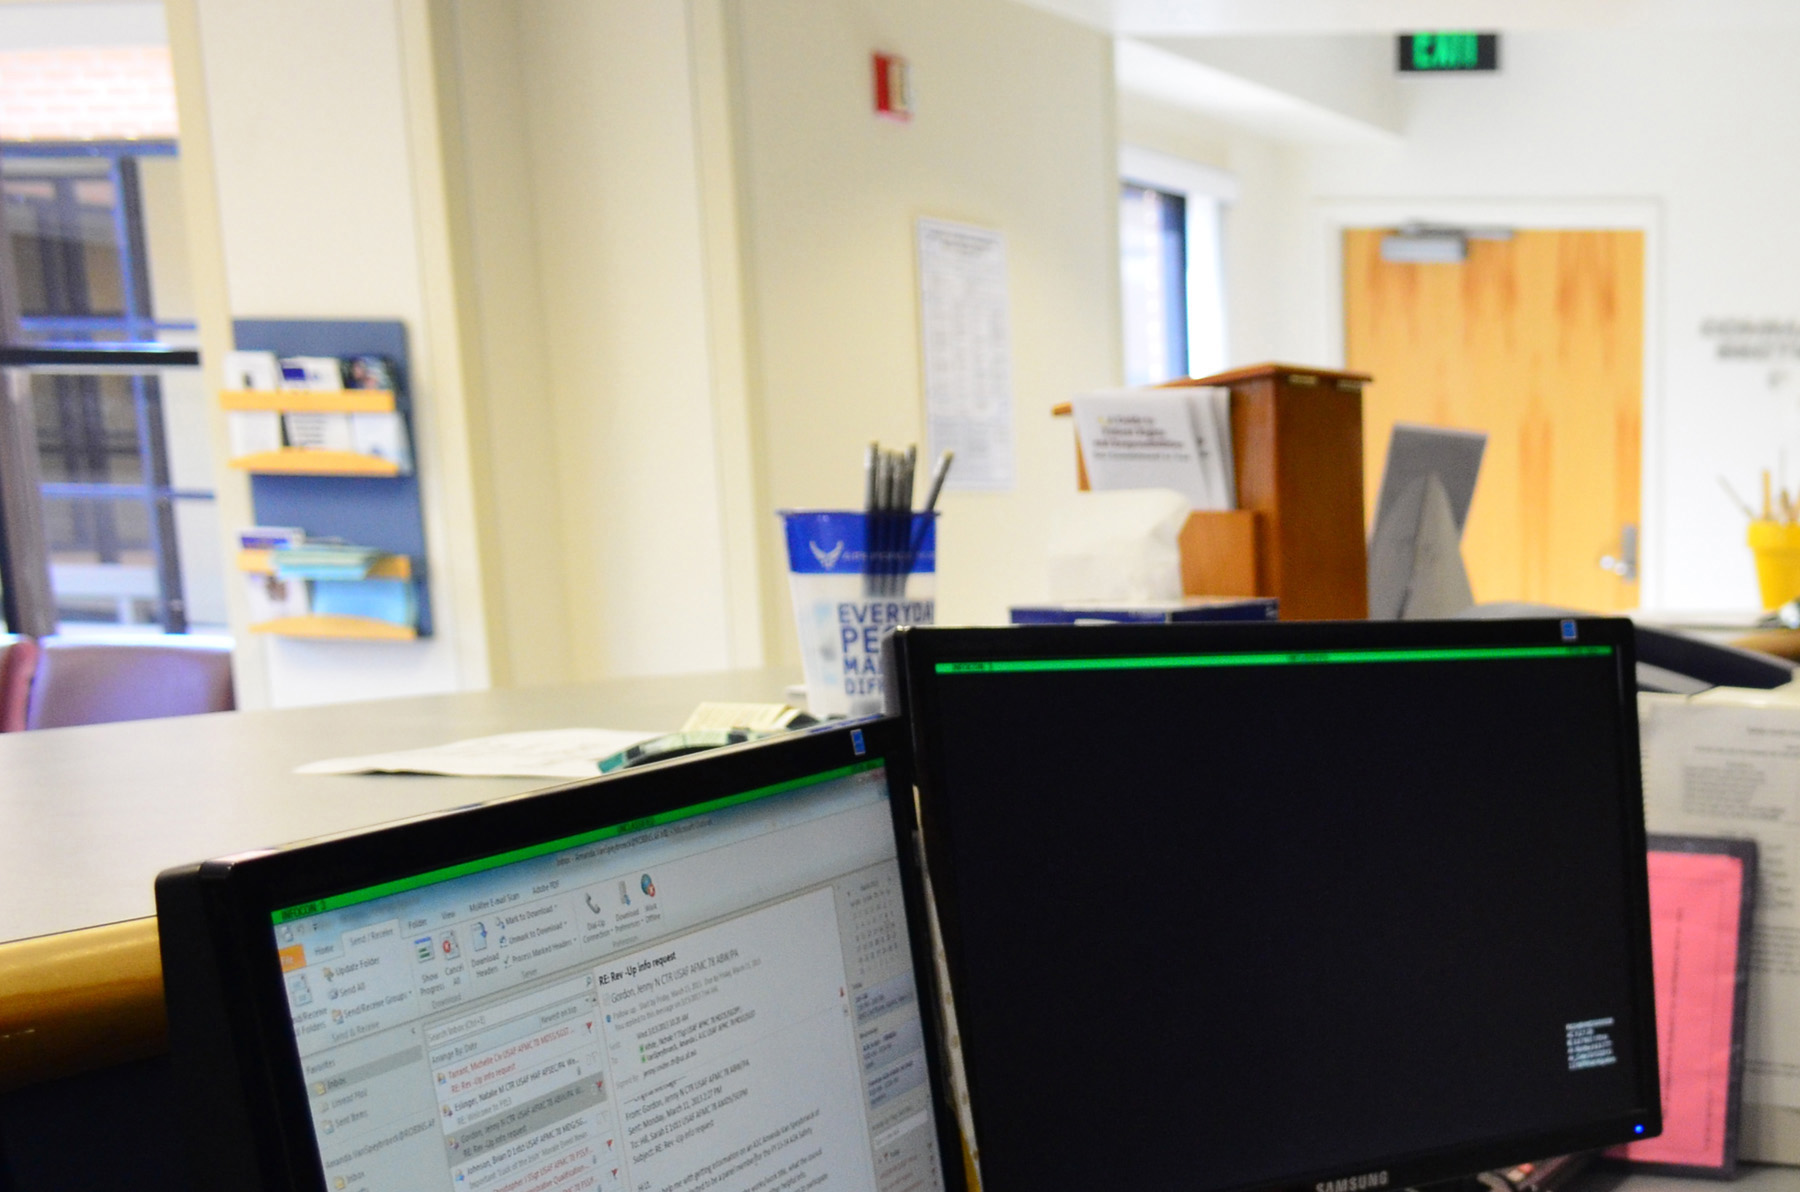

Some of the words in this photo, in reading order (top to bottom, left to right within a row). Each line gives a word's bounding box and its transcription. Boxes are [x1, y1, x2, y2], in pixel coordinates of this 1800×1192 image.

[842, 626, 900, 654] PE
[844, 656, 884, 676] MA
[609, 968, 624, 983] Rev
[636, 958, 652, 973] info
[650, 949, 677, 968] request
